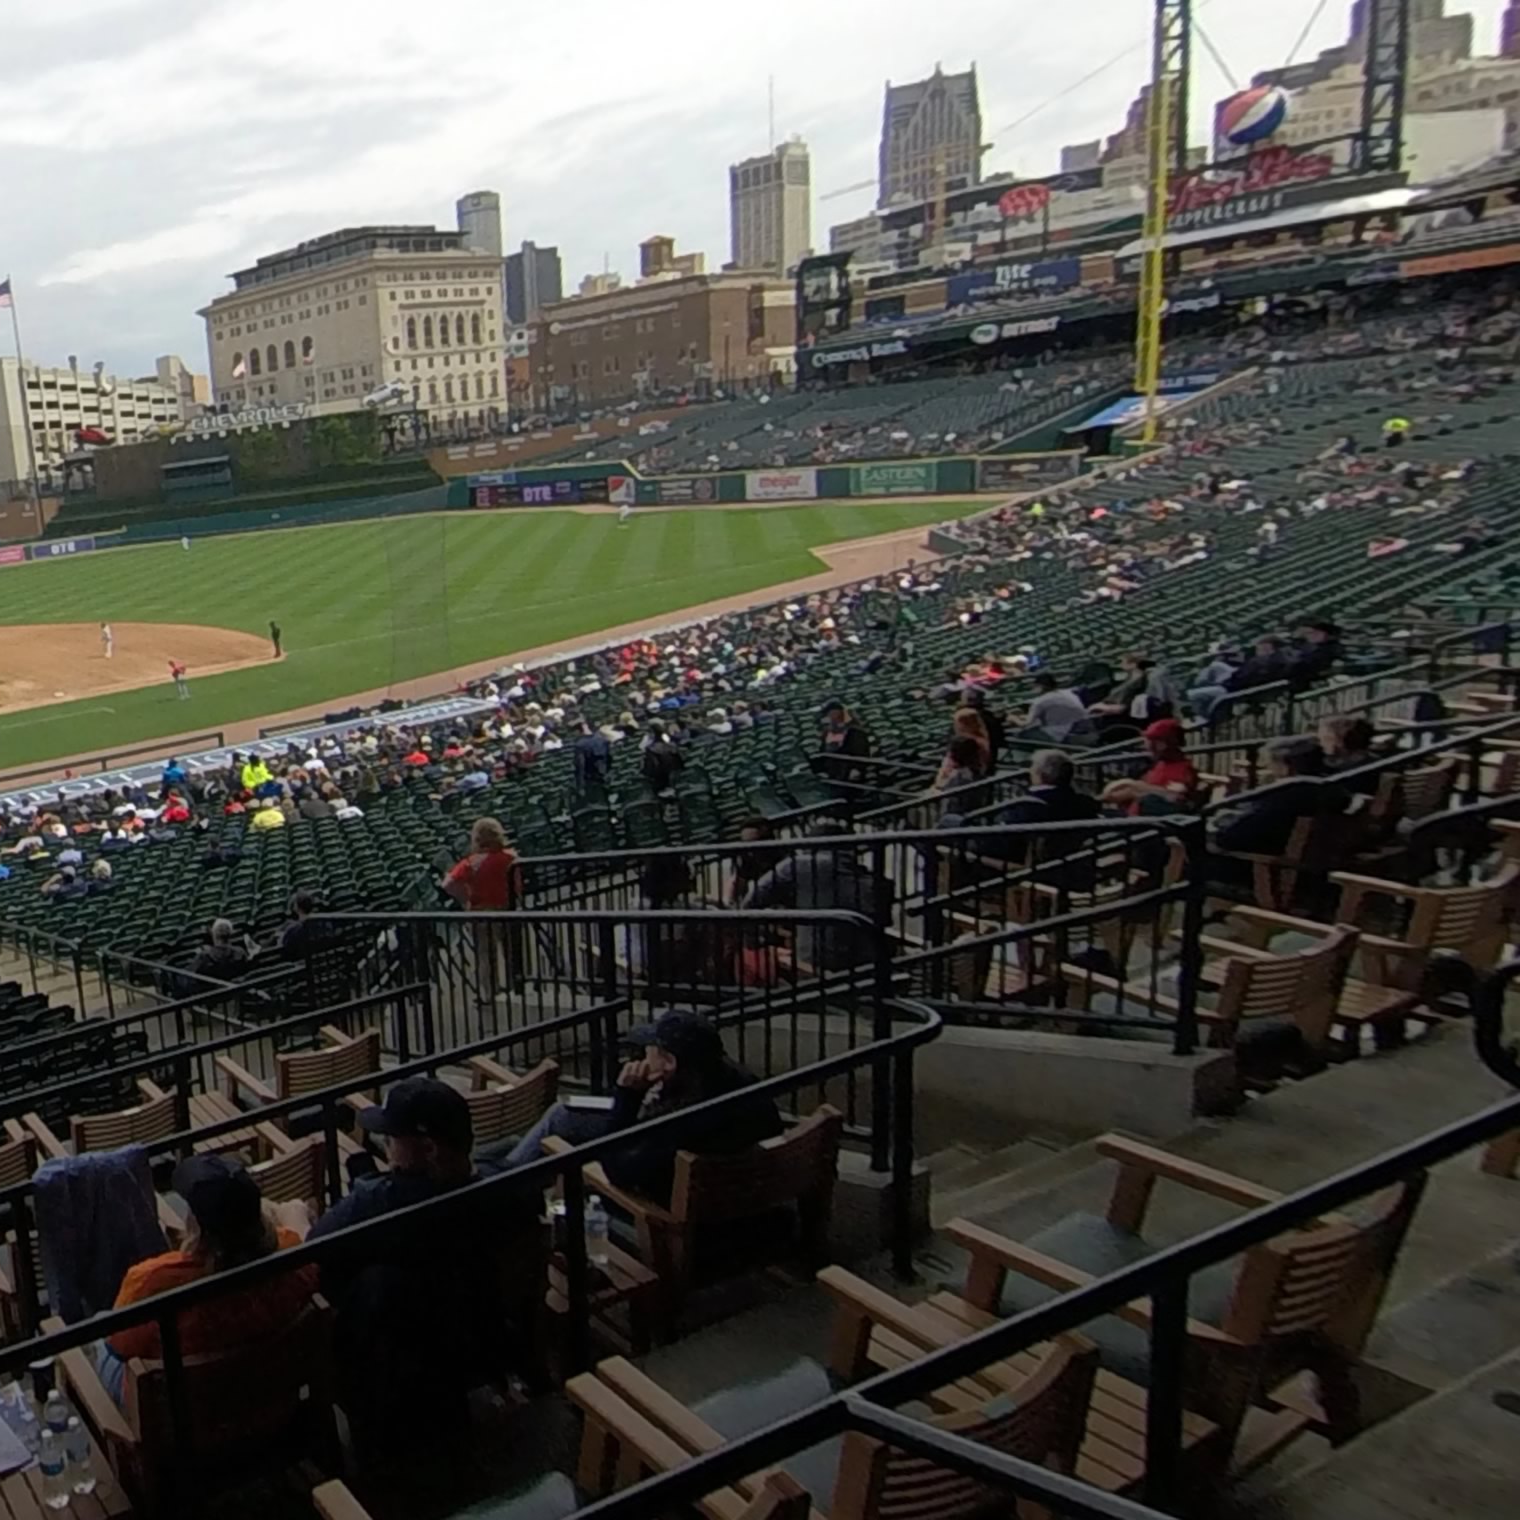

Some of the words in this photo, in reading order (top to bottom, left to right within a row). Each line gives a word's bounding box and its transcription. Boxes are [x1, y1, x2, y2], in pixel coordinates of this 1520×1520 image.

[191, 402, 306, 431] CHEVROLET
[523, 485, 553, 503] DTE
[50, 541, 76, 555] DTE
